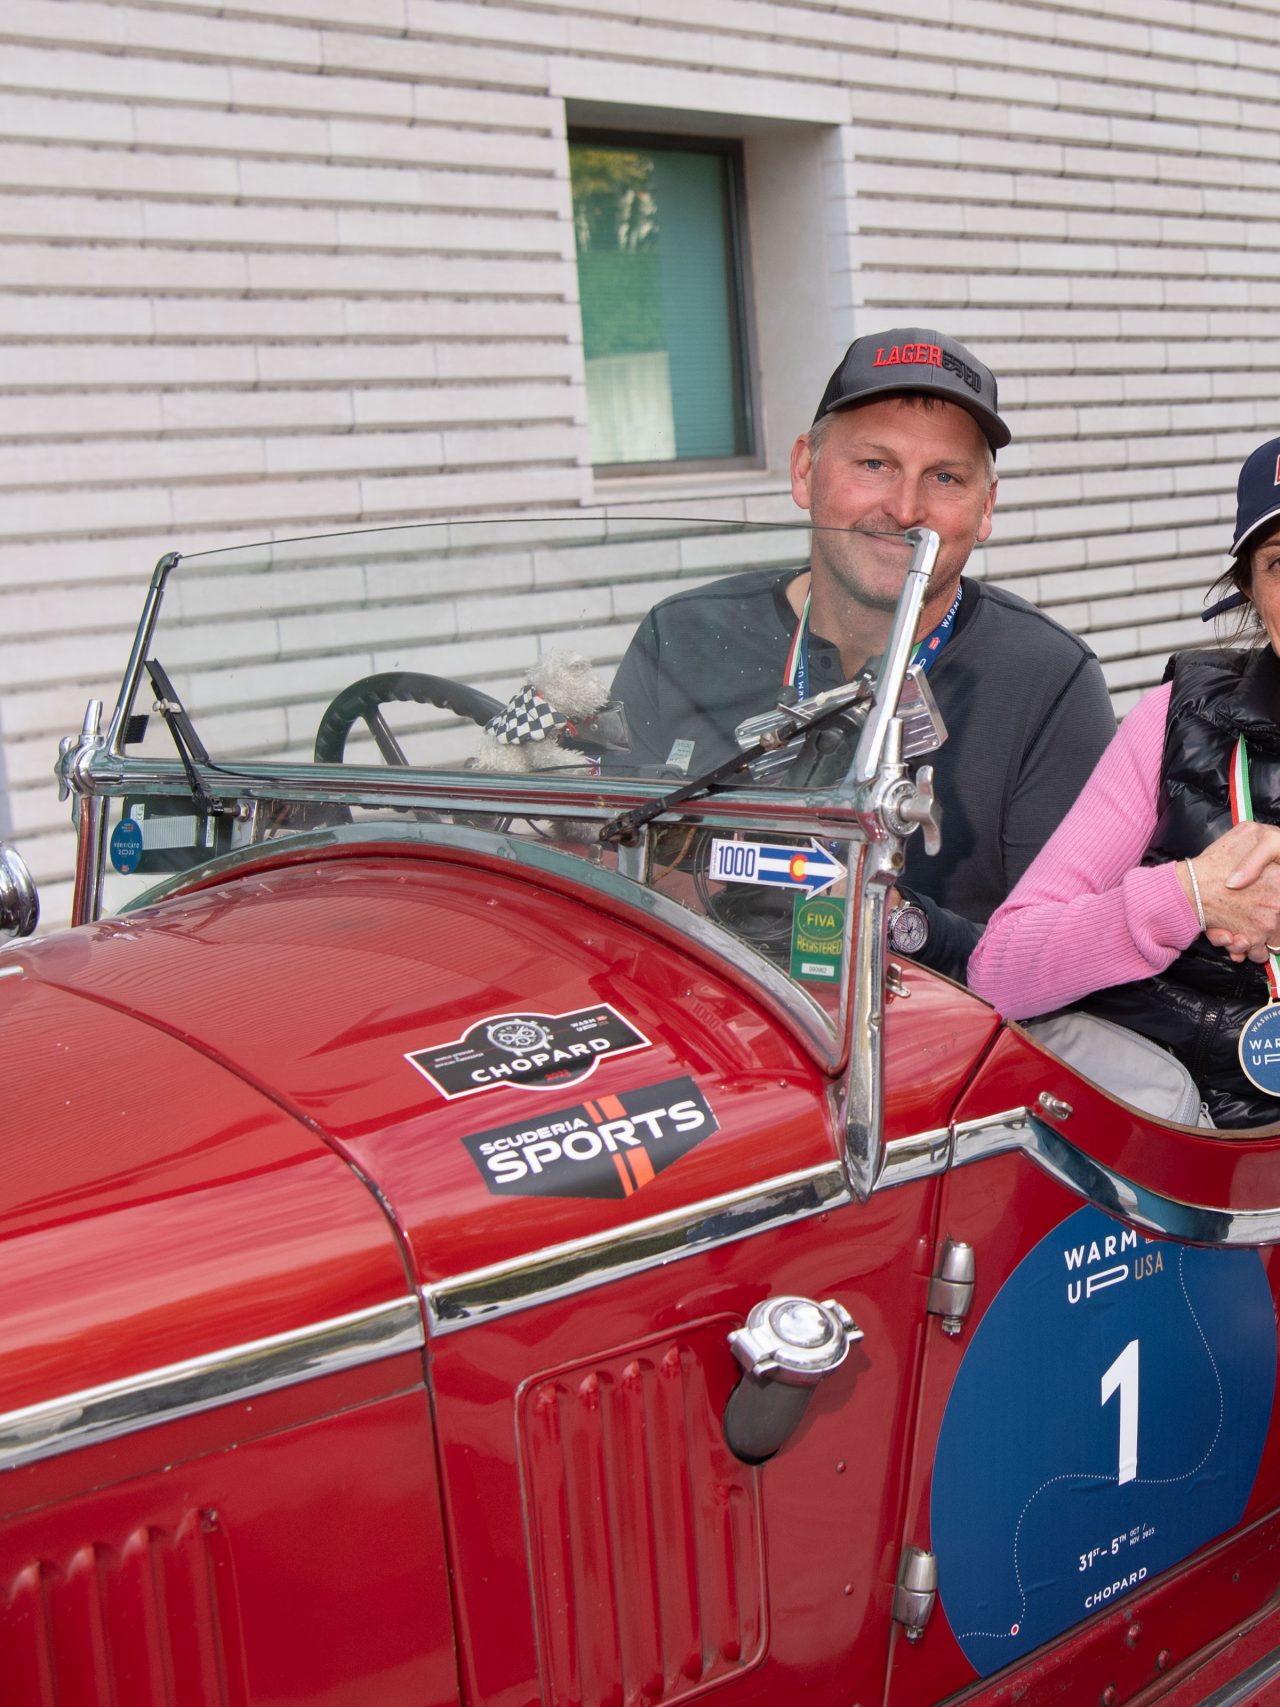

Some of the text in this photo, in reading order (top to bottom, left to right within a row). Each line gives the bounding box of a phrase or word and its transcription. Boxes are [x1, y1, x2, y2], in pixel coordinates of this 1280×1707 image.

[941, 600, 960, 629] WARM
[717, 845, 756, 878] 1000
[806, 912, 836, 929] FIVA
[796, 934, 843, 956] REGISTERED
[471, 1037, 611, 1083] CHOPARD
[479, 1117, 589, 1156] SCUDERIA
[486, 1100, 705, 1184] SPORTS
[1063, 1229, 1138, 1271] WARM
[1067, 1250, 1164, 1304] UP USA
[1101, 1338, 1139, 1486] 1
[1084, 1567, 1148, 1608] CHOPARD
